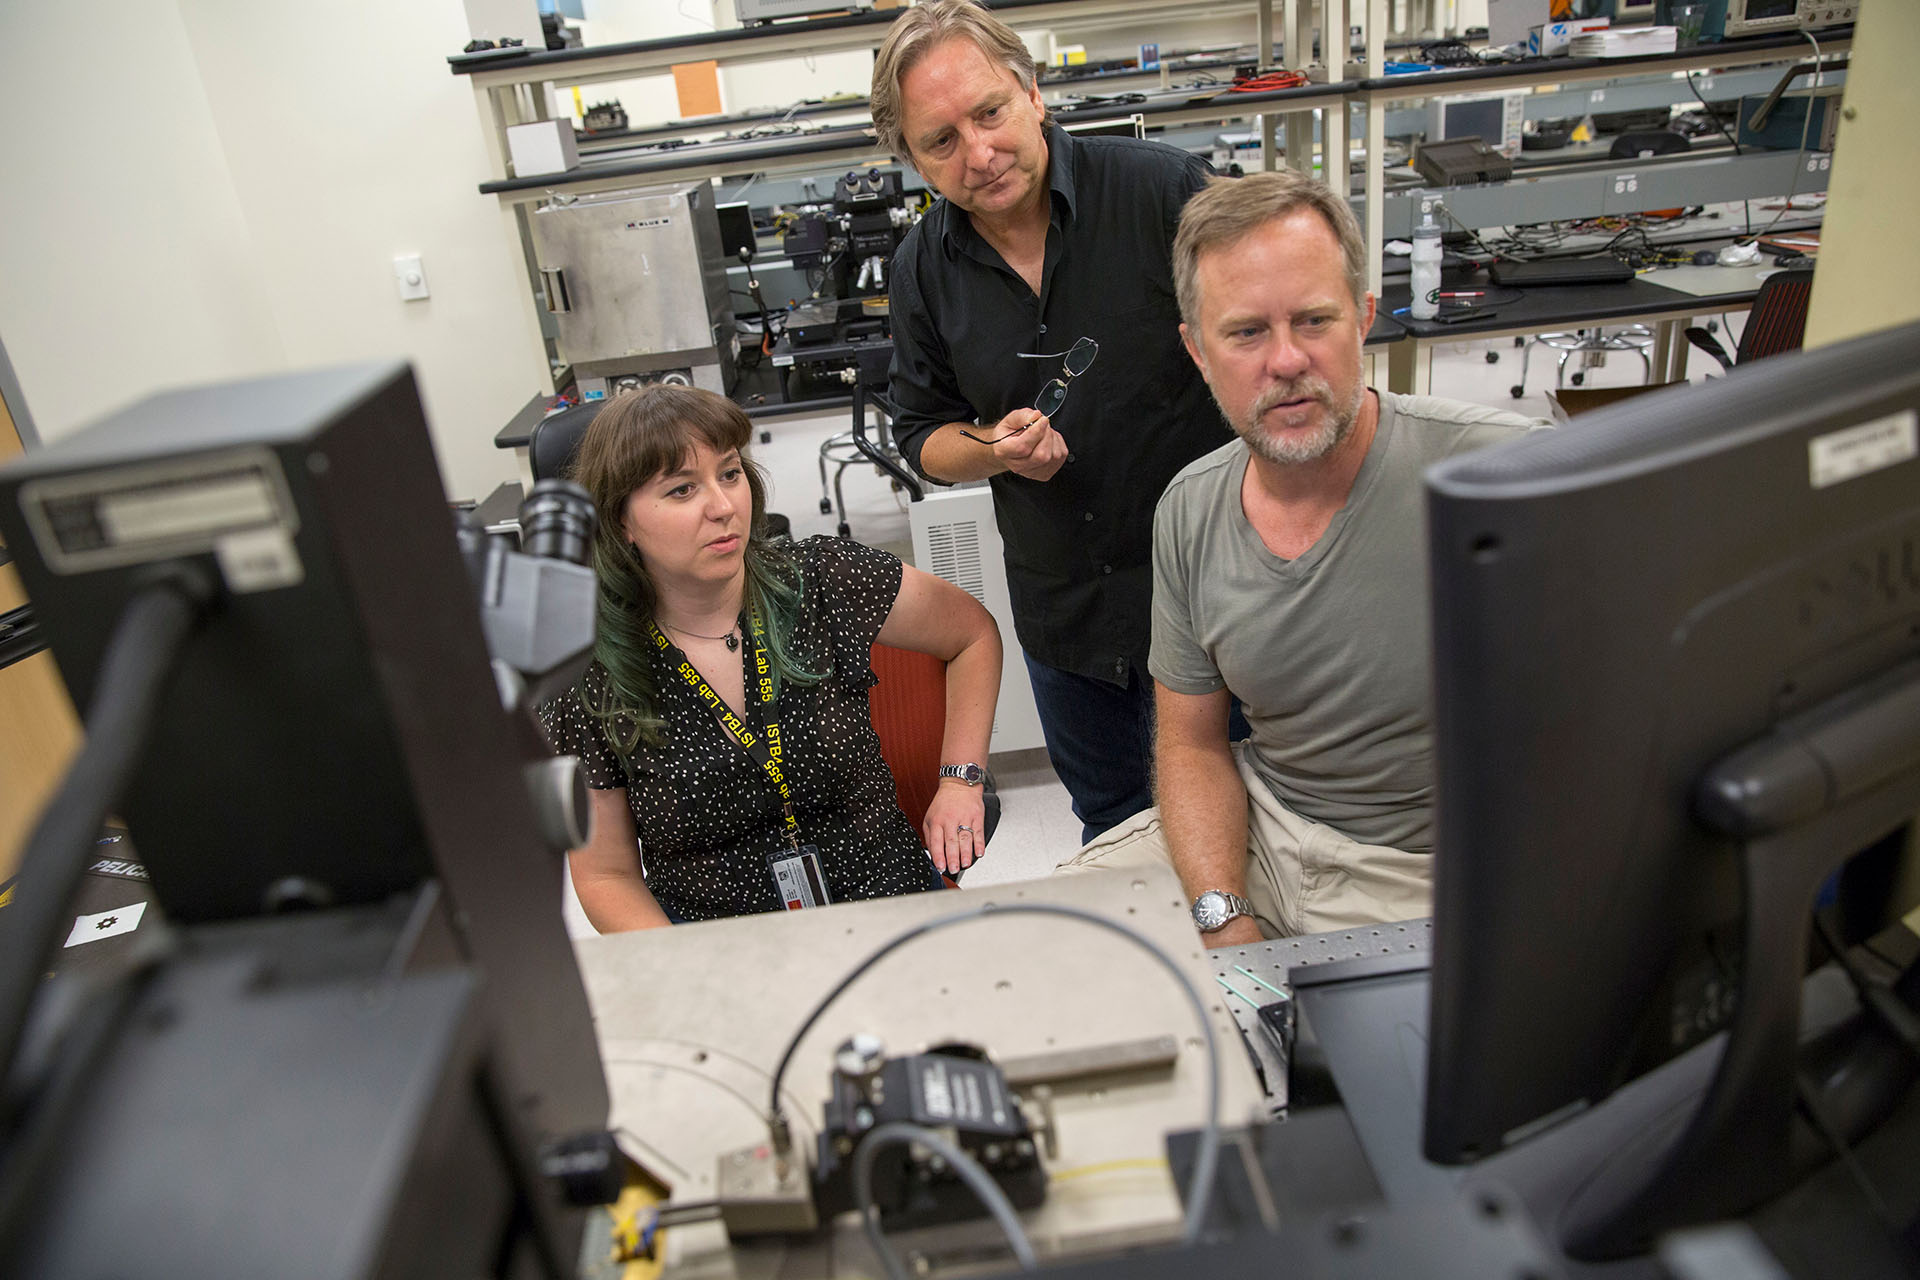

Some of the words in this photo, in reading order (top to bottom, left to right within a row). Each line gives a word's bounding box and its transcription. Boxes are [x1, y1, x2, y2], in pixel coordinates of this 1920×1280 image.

[755, 648, 769, 674] Lab
[678, 662, 700, 686] 555
[698, 683, 720, 708] Lab
[760, 677, 773, 702] 555
[722, 711, 757, 748] ISTB4
[763, 760, 784, 784] 555
[89, 860, 151, 879] PELICA
